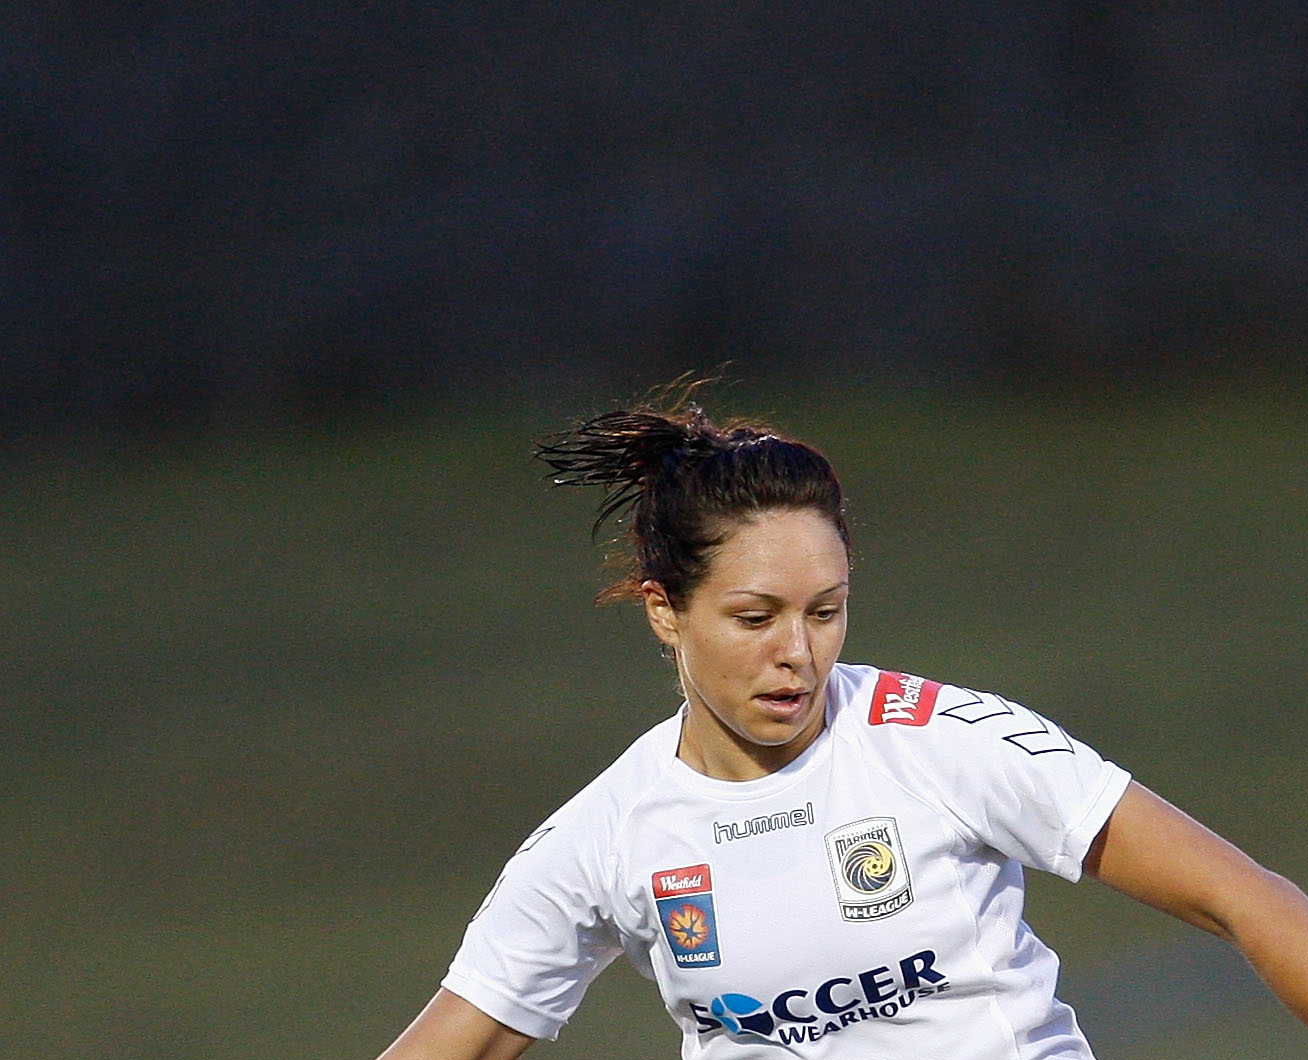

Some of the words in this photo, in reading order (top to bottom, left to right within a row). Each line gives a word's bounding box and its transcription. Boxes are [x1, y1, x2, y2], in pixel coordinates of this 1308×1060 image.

[713, 802, 814, 844] hummel
[834, 827, 893, 864] MARINERS
[660, 875, 702, 891] Westfield
[844, 891, 909, 918] W-LEAGUE
[778, 982, 950, 1046] WEARHOUSE
